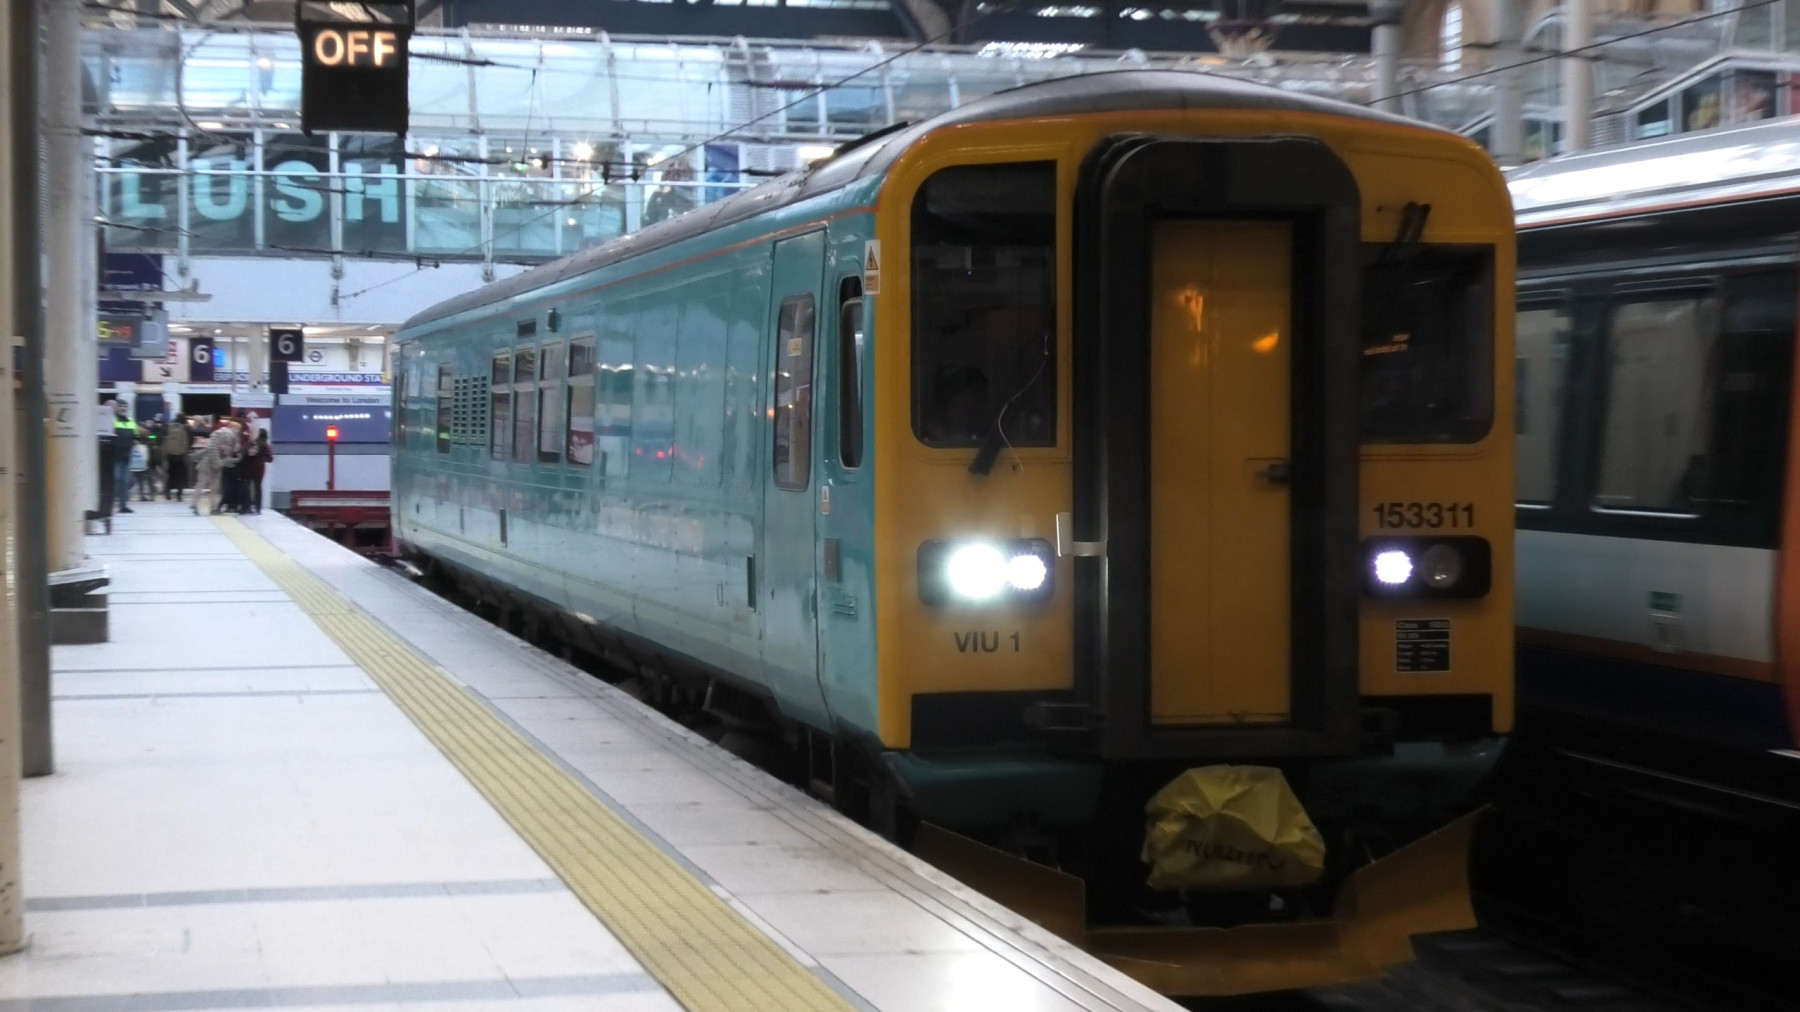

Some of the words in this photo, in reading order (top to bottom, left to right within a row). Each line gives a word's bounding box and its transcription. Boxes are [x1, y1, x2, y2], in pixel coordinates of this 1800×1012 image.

[314, 29, 396, 66] OFF
[120, 156, 399, 223] LUSH
[192, 344, 210, 364] 6
[277, 333, 295, 355] 6
[288, 373, 362, 383] UNDERGROUND
[1373, 502, 1475, 529] 153311
[953, 631, 999, 653] VIU
[1009, 631, 1020, 653] 1
